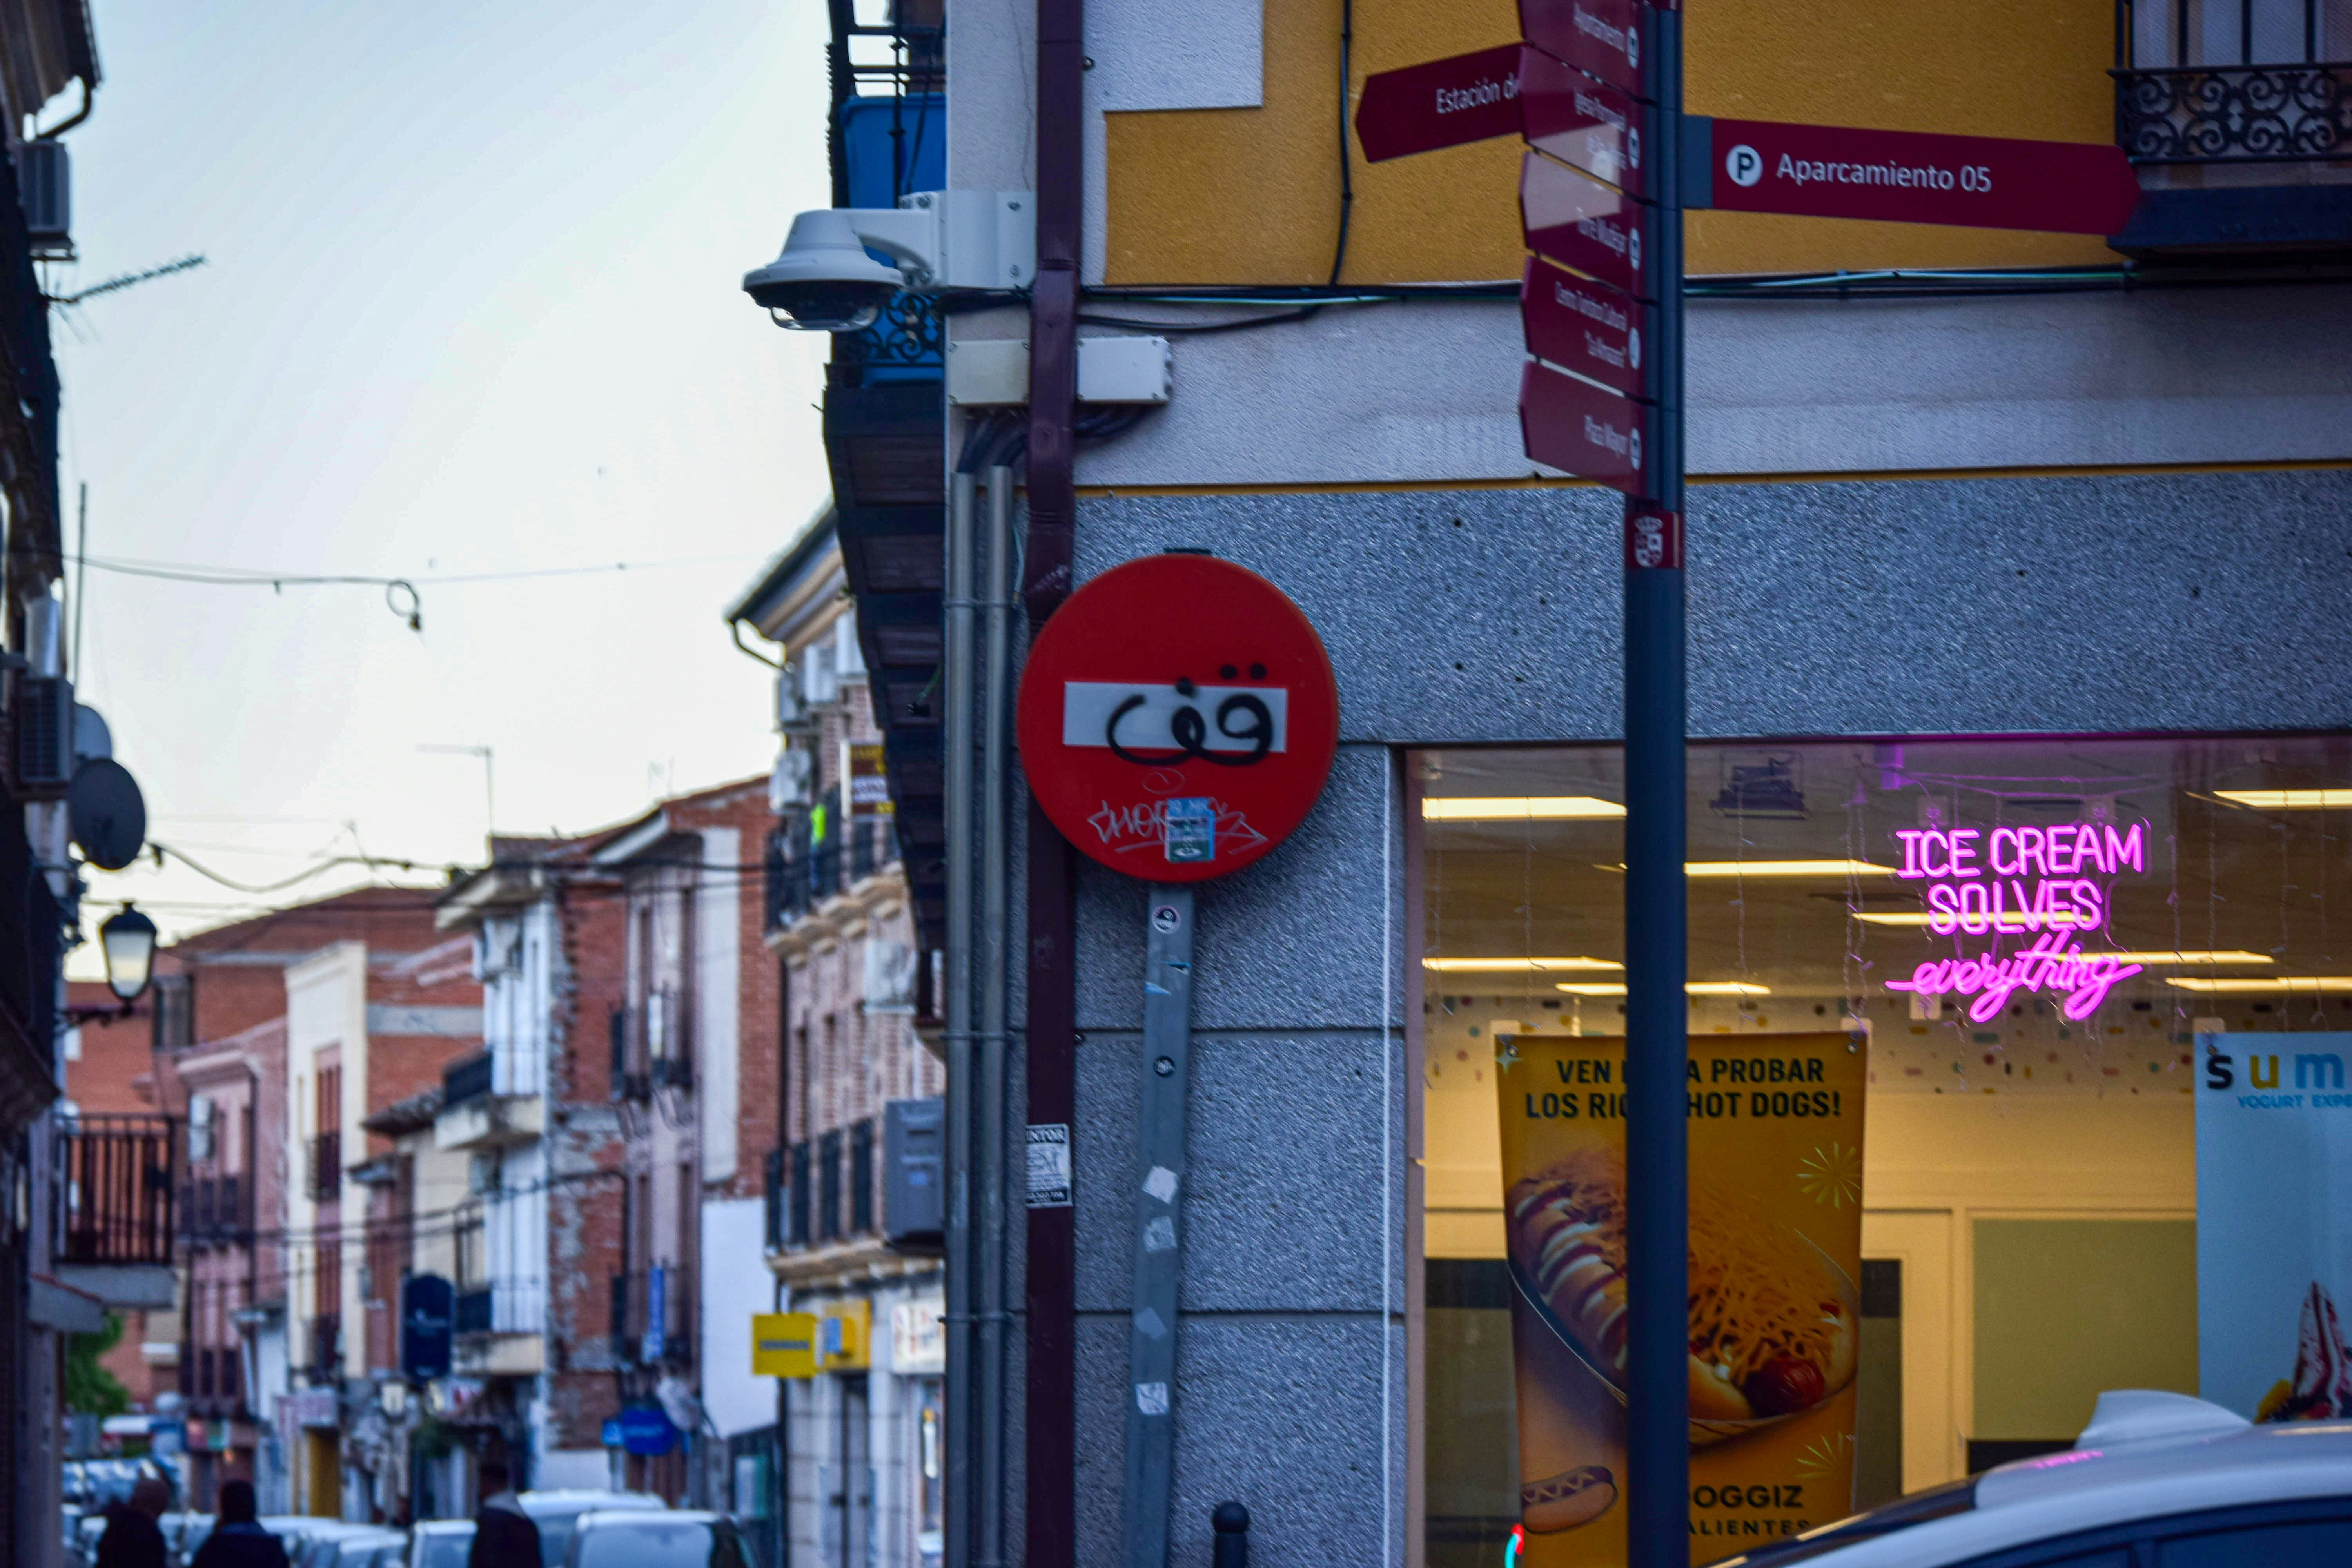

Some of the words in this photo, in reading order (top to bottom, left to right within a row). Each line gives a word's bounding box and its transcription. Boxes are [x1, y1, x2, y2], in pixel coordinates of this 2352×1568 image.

[1436, 76, 1500, 114] Estación
[1776, 152, 1955, 191] Aparcamiento
[1960, 165, 1993, 193] 05
[1896, 828, 1981, 878] ICE
[1989, 824, 2143, 876] CREAM
[1928, 879, 2103, 935] SOLVES
[1884, 928, 2143, 1023] everything
[1556, 1059, 1611, 1084] VEN
[1711, 1058, 1825, 1083] PROBAR
[1525, 1092, 1579, 1119] LOS
[1687, 1091, 1744, 1119] HOT
[1750, 1091, 1842, 1118] DOGS!
[2237, 1095, 2303, 1109] YOGURT
[1693, 1484, 1804, 1509] OGGIZ
